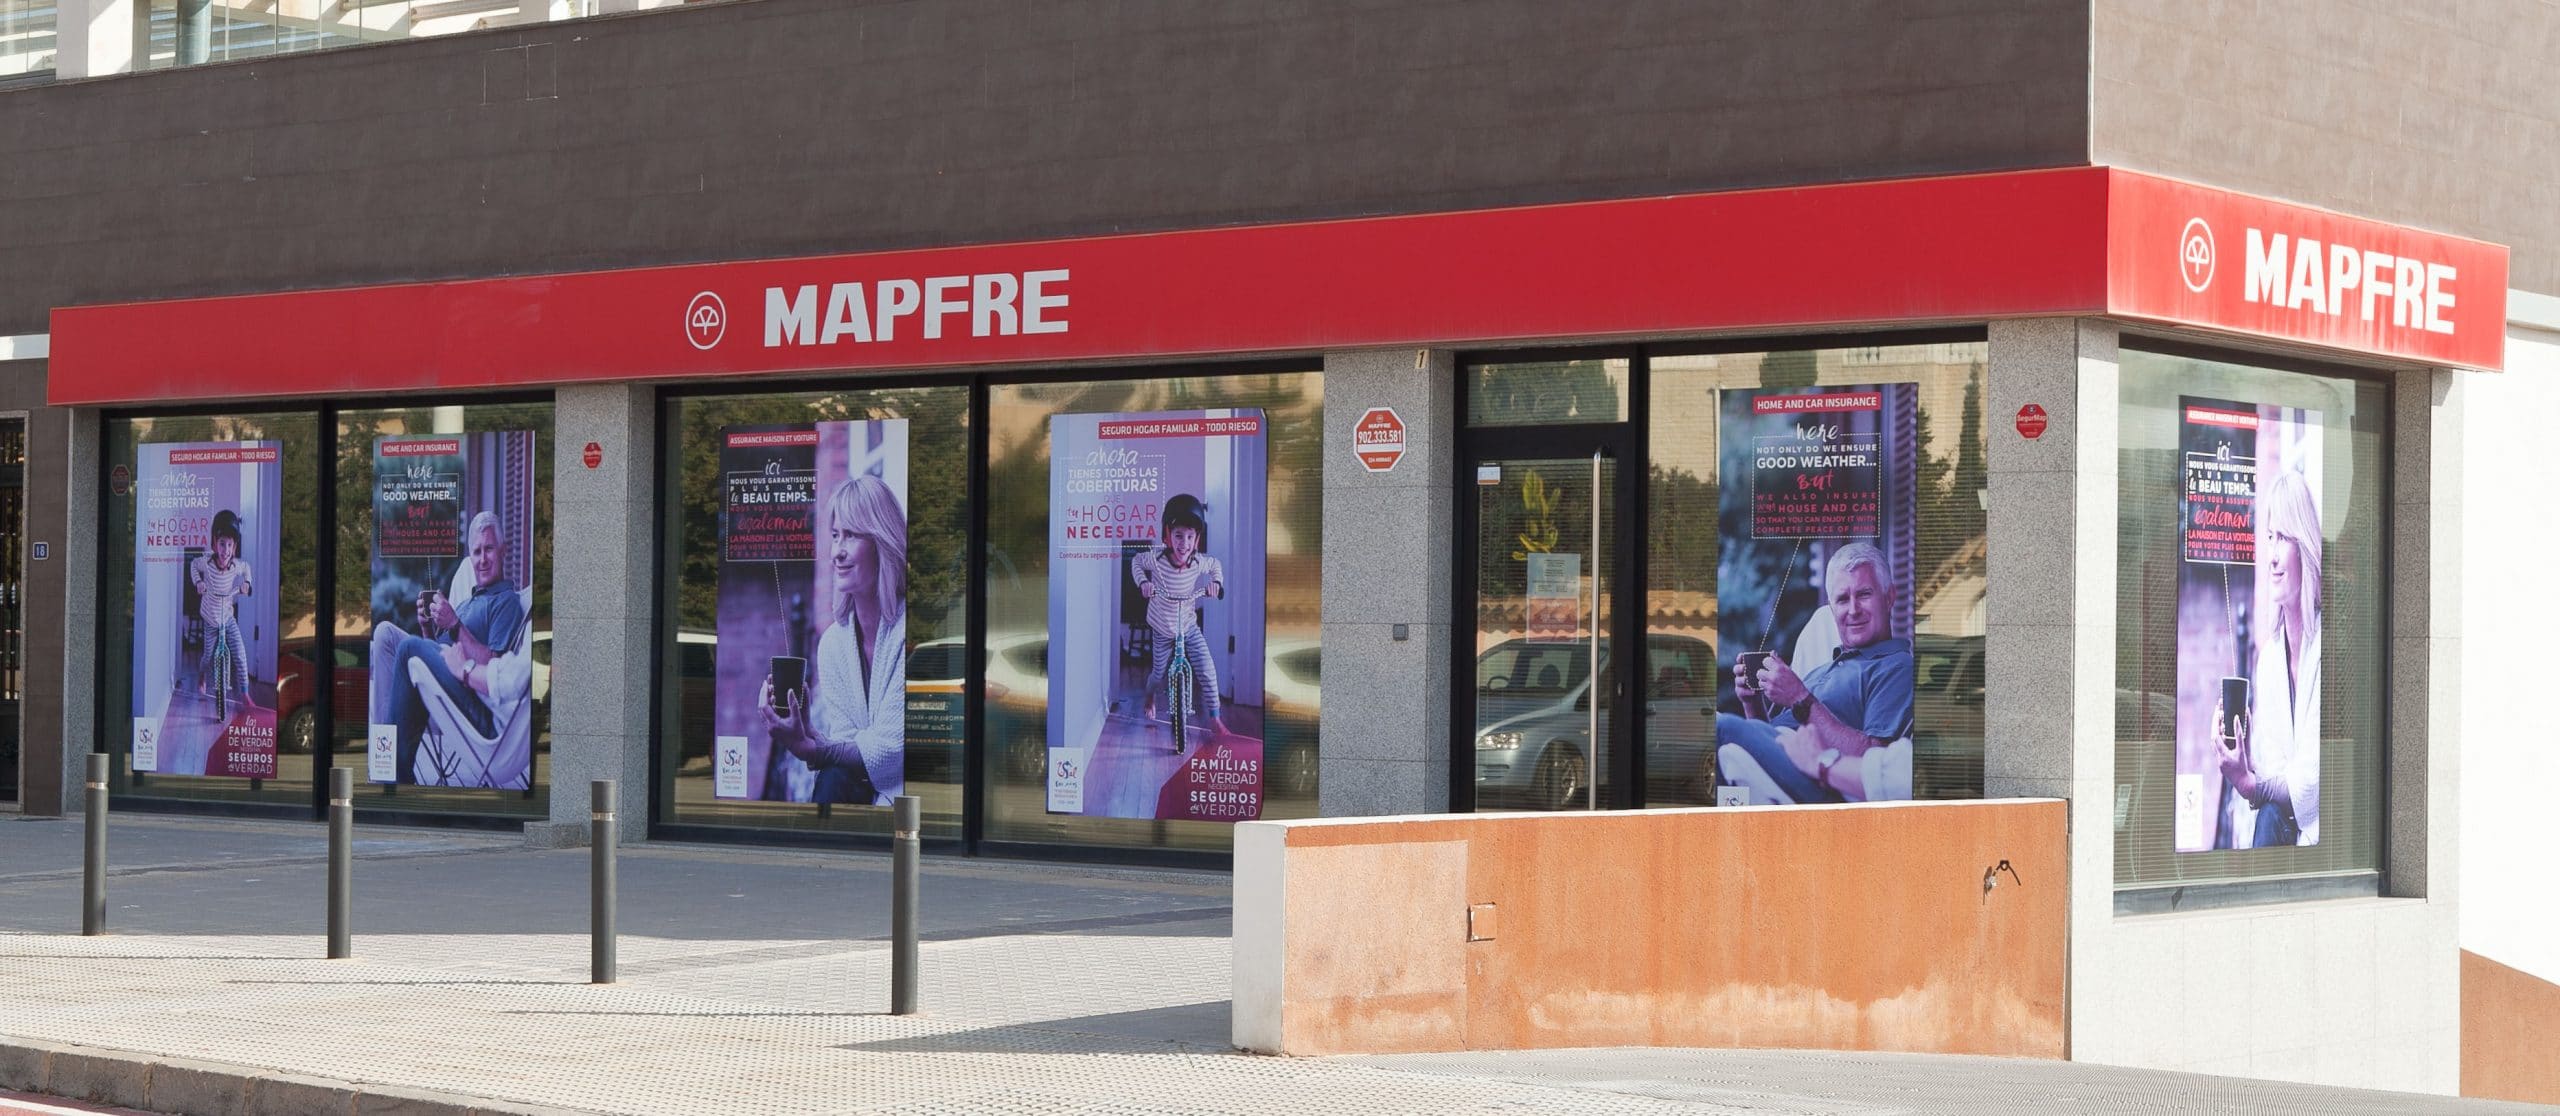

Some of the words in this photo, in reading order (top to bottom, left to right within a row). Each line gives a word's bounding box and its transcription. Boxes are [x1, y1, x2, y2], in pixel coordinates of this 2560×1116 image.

[2245, 228, 2456, 335] MAPFRE
[764, 269, 1069, 347] MAPFRE
[1757, 400, 1782, 410] HOME
[1785, 399, 1803, 409] AND
[1805, 399, 1823, 408] CAR
[1826, 397, 1877, 407] INSURANCE
[1102, 425, 1132, 435] SEGURO
[1133, 425, 1159, 434] HOGAR
[1162, 423, 1199, 433] FAMILIAR
[1206, 423, 1226, 432] TODO
[1228, 422, 1257, 432] RIESGO
[1796, 422, 1839, 442] here
[1358, 430, 1401, 443] 902.333.581
[2217, 441, 2231, 460] ici
[1086, 448, 1138, 468] ahora
[1757, 457, 1796, 469] GOOD
[1801, 455, 1877, 468] WEATHER...
[2189, 460, 2203, 469] NOUS
[408, 464, 433, 479] here
[765, 459, 782, 475] ici
[1068, 469, 1101, 479] TIENES
[1104, 468, 1136, 478] TODAS
[1139, 467, 1158, 477] LAS
[1066, 478, 1158, 493] COBERTURAS
[2199, 480, 2221, 493] BEAU
[148, 497, 209, 508] COBERTURAS
[383, 491, 407, 501] GOOD
[743, 493, 770, 503] BEAU
[774, 492, 816, 502] TEMPS...
[1082, 505, 1157, 522] HOGAR
[1778, 504, 1817, 513] HOUSE
[1823, 504, 1847, 512] AND
[1853, 503, 1876, 511] CAR
[158, 518, 208, 533] HOGAR
[1067, 525, 1157, 539] NECESITA
[147, 536, 208, 546] NECESITA
[229, 726, 273, 736] FAMILIAS
[229, 737, 239, 746] DE
[241, 737, 273, 747] VERDAD
[228, 753, 273, 763] SEGUROS
[235, 764, 272, 773] VERDAD
[1192, 758, 1257, 772] FAMILIAS
[1191, 772, 1206, 783] DE
[1209, 772, 1257, 784] VERDAD
[1191, 791, 1257, 804] SEGUROS
[1202, 804, 1257, 817] VERDAD
